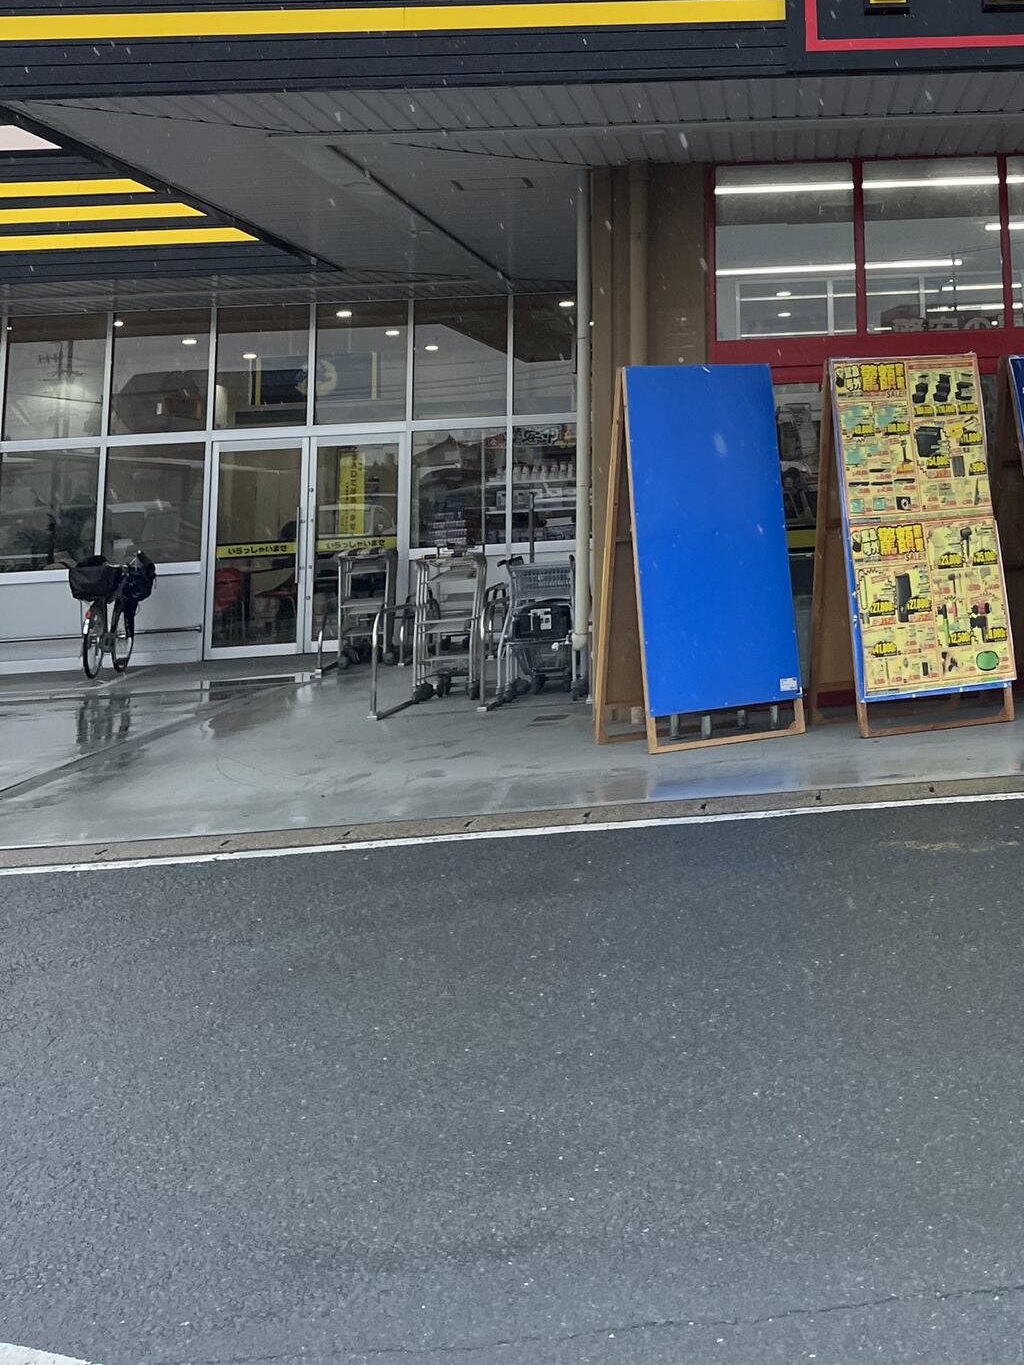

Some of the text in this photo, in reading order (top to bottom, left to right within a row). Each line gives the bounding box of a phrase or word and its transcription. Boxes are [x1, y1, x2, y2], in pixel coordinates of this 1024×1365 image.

[228, 544, 288, 554] いらっしゃいませ
[326, 539, 386, 549] いらっしゃいませ
